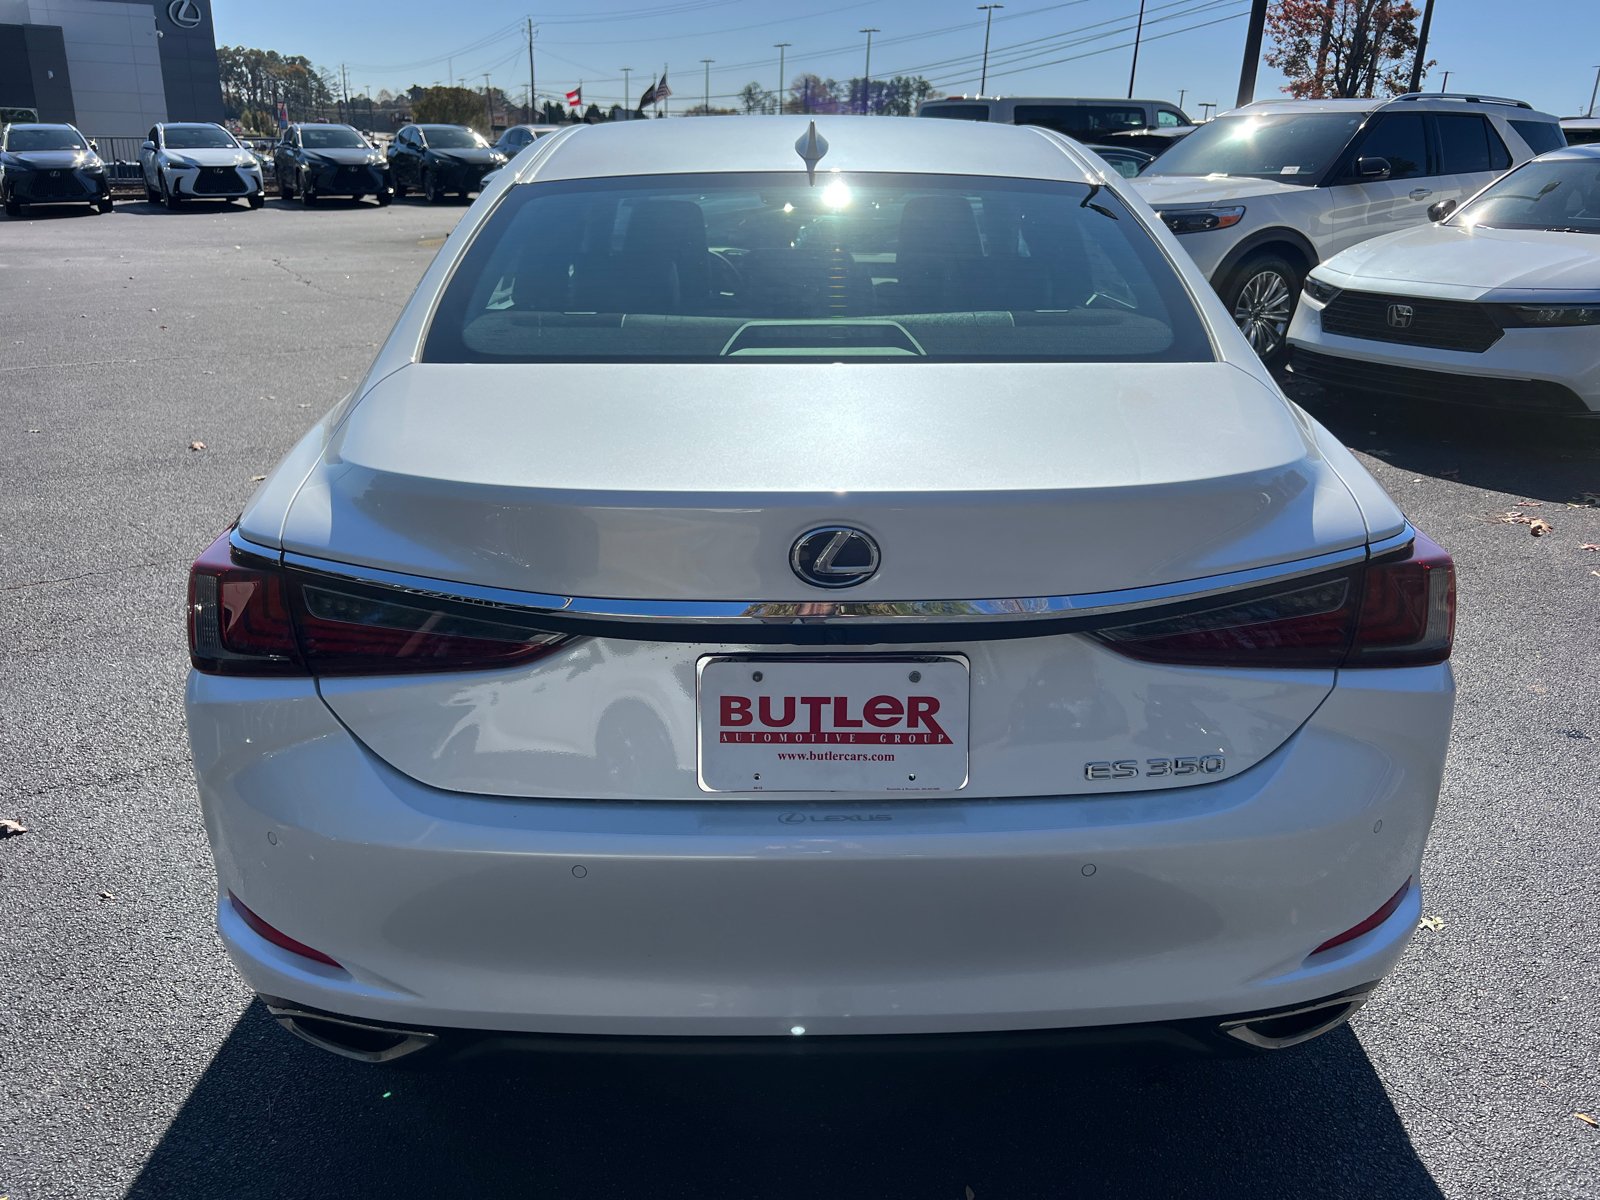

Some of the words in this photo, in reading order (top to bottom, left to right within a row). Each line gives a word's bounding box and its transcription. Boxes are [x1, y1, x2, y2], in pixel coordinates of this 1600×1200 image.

[721, 733, 856, 743] AUTOMOTIVE
[880, 733, 945, 743] GROUP
[777, 751, 895, 762] www.butlercars.com
[1084, 760, 1139, 781] ES
[1146, 755, 1225, 778] 350
[809, 814, 892, 822] LEXUS
